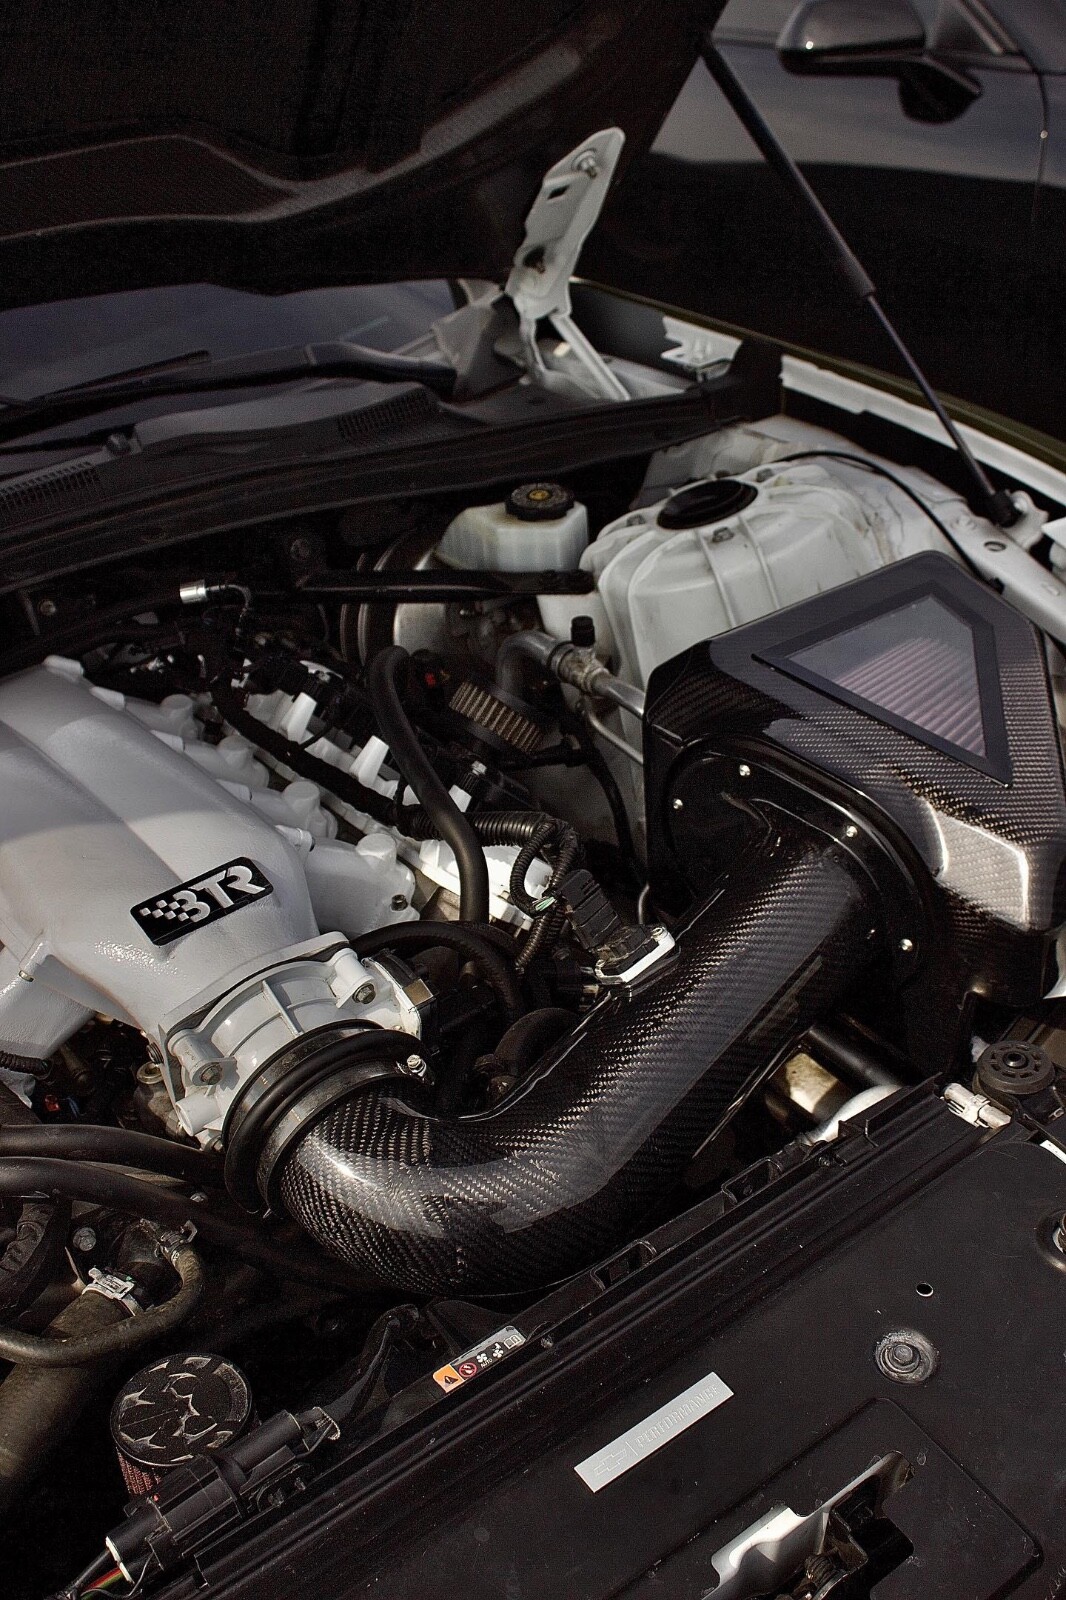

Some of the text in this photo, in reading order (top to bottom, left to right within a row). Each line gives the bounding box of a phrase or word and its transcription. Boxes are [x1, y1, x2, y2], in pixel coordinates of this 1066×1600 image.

[150, 865, 266, 922] BTR
[480, 1358, 493, 1369] AUTO
[635, 1384, 721, 1449] PERFORMANCE
